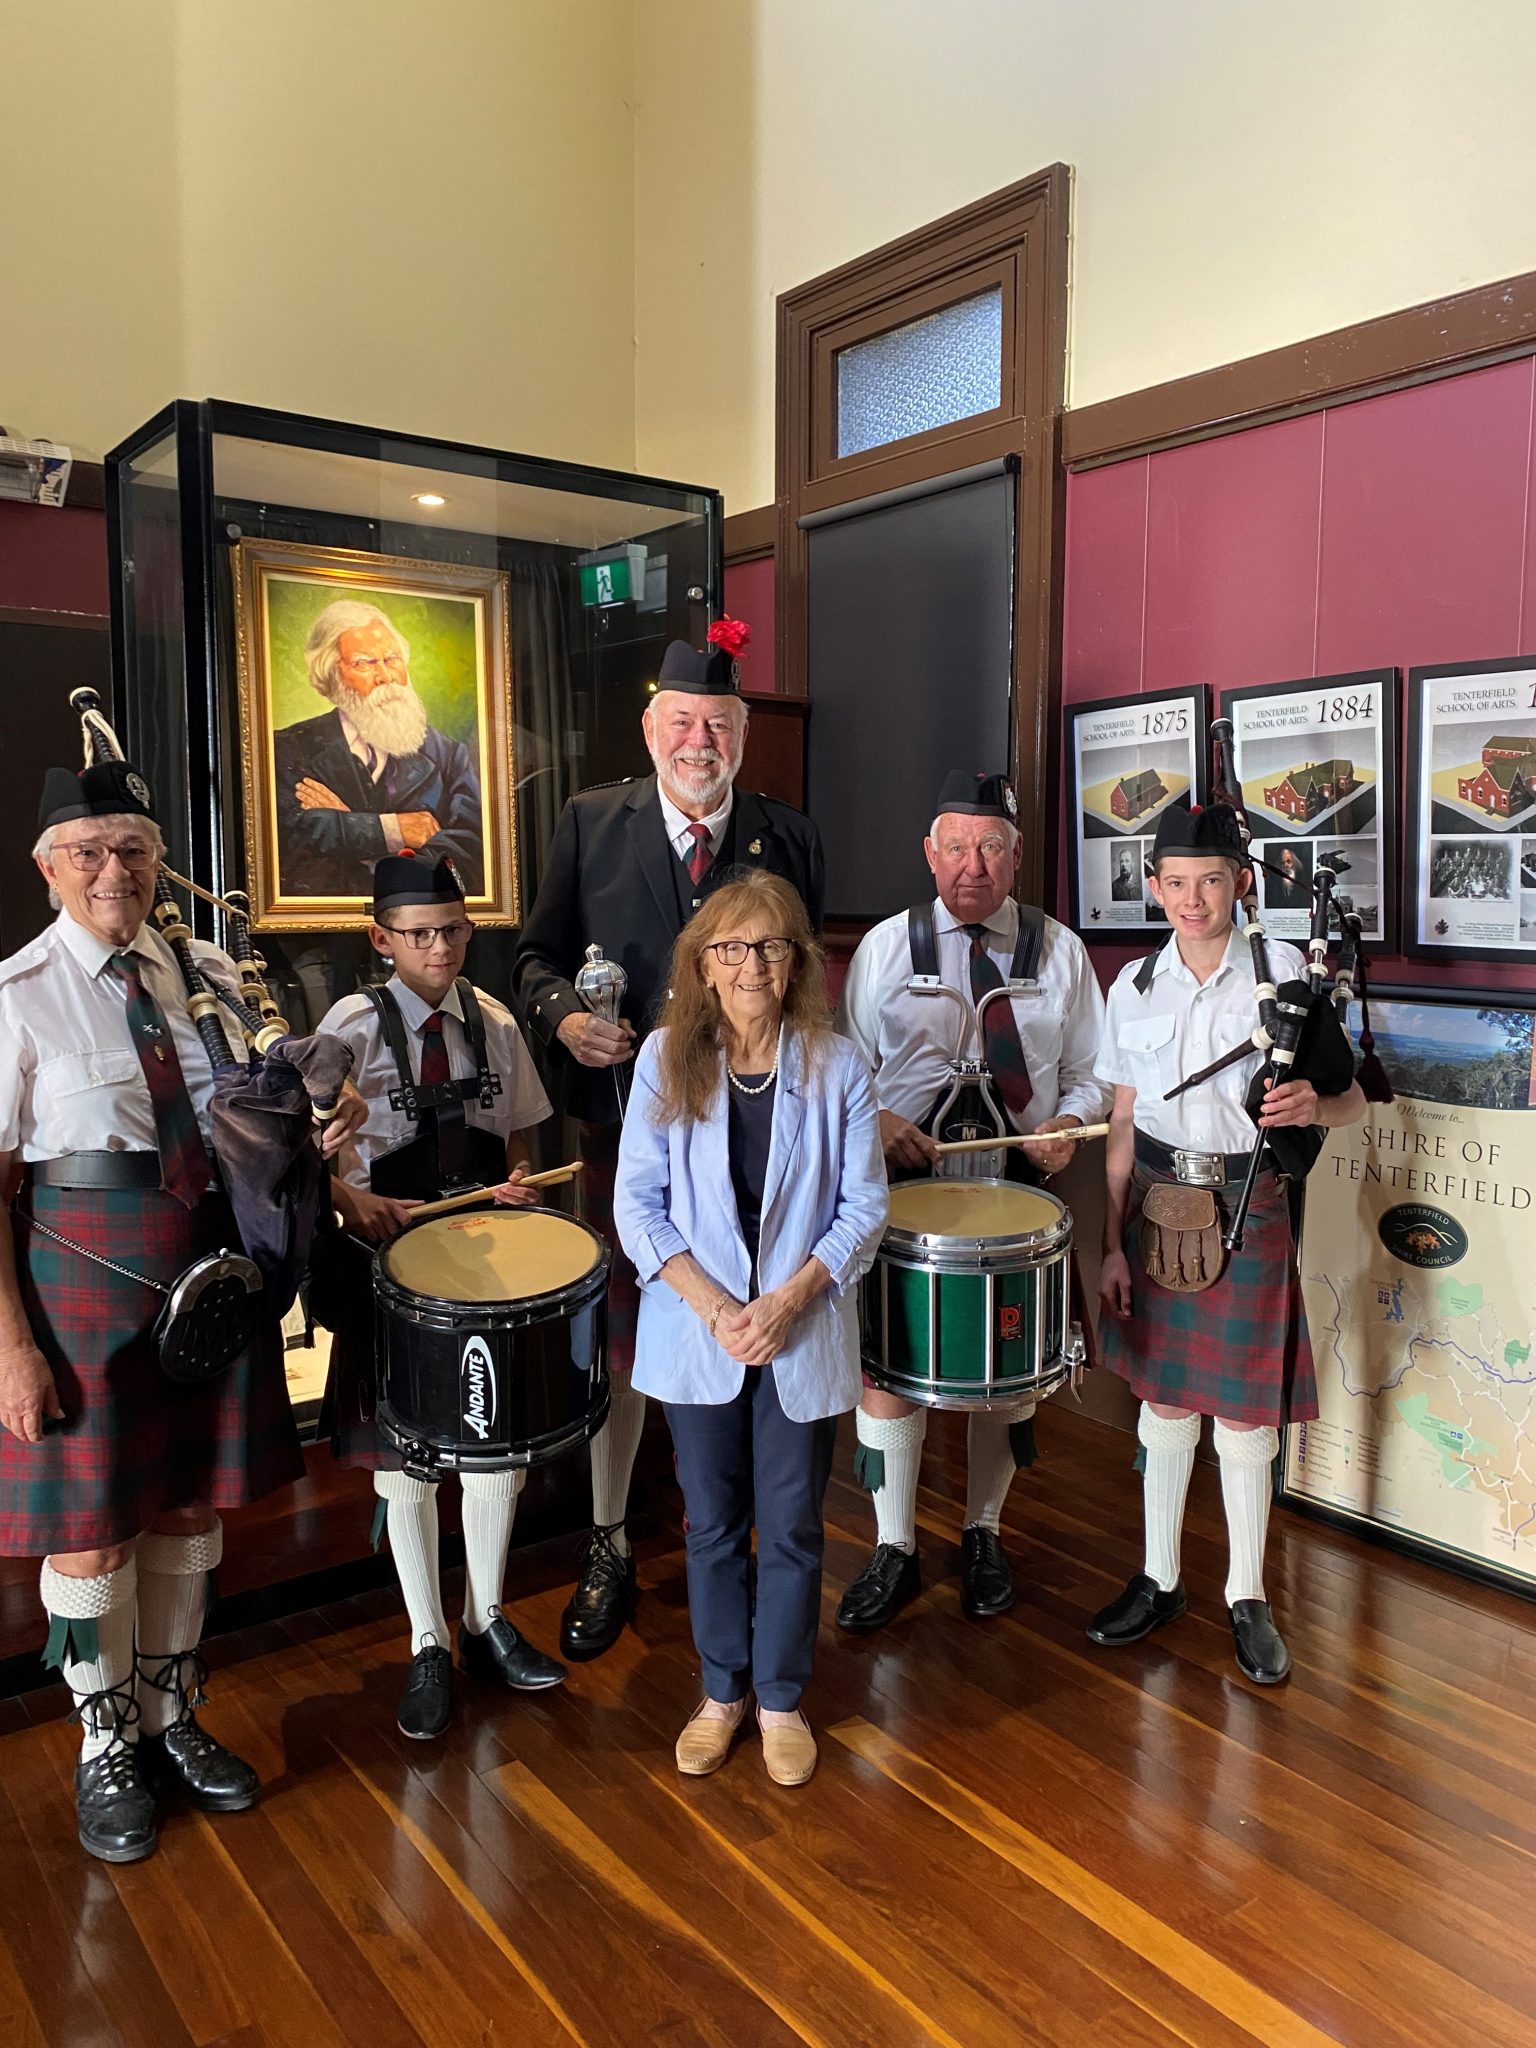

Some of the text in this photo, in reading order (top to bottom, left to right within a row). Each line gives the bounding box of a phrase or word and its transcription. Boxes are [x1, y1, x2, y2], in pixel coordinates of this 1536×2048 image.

[1452, 687, 1516, 701] TENTERFIELD
[1256, 705, 1308, 719] TENTERFIELD
[1317, 693, 1373, 723] 1884
[1436, 699, 1516, 714] SCHOOL OF ARTS
[1093, 719, 1135, 732] TENTERFIELD
[1142, 709, 1187, 736] 1875
[1243, 715, 1308, 730] SCHOOL OF ARTS
[1083, 729, 1135, 742] SCHOOL OF ARTS
[1396, 1103, 1447, 1121] Welcome
[961, 1126, 977, 1140] M
[1361, 1125, 1501, 1165] SHIRE OF
[1331, 1156, 1532, 1210] TENTERFIELD
[1397, 1207, 1450, 1225] TENTERFIELD
[1415, 1254, 1453, 1265] COUNCIL
[463, 1353, 489, 1440] ANDANTE
